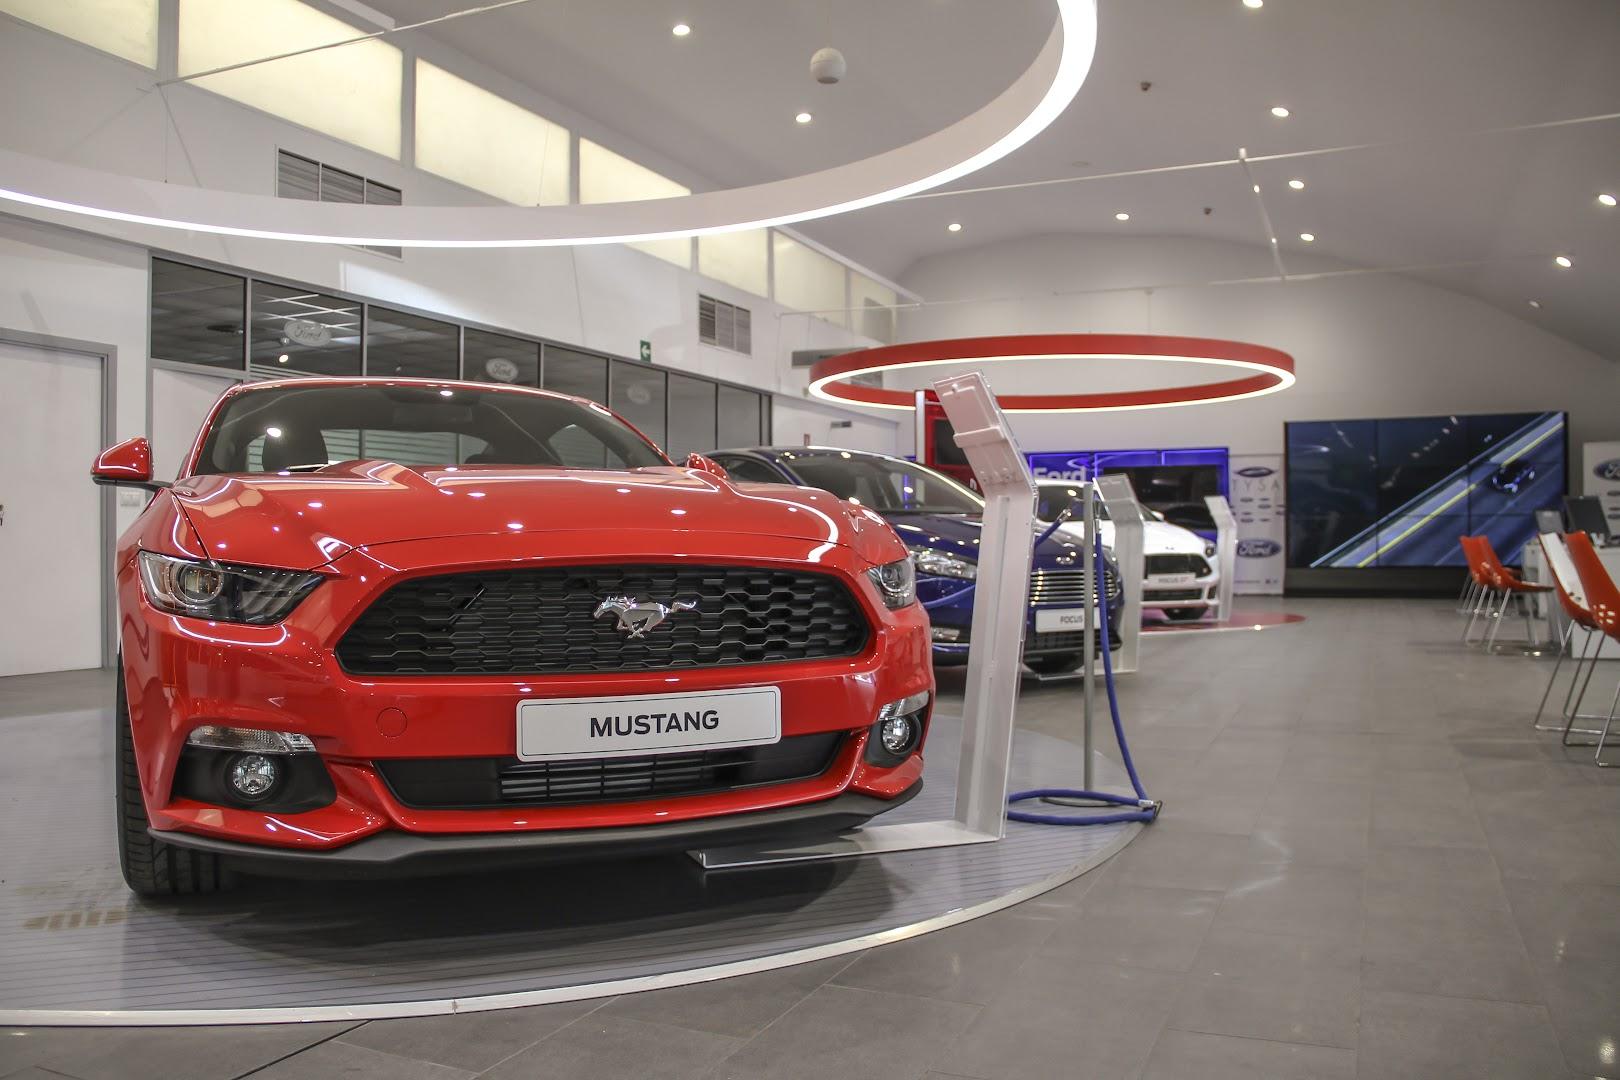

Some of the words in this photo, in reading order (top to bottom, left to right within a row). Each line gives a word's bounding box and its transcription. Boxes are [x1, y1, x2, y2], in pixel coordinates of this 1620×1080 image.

[1033, 466, 1087, 481] Ford
[1232, 479, 1280, 491] TYSA
[1239, 541, 1272, 556] Ford
[1060, 615, 1083, 624] FOCUS
[590, 710, 719, 738] MUSTANG
